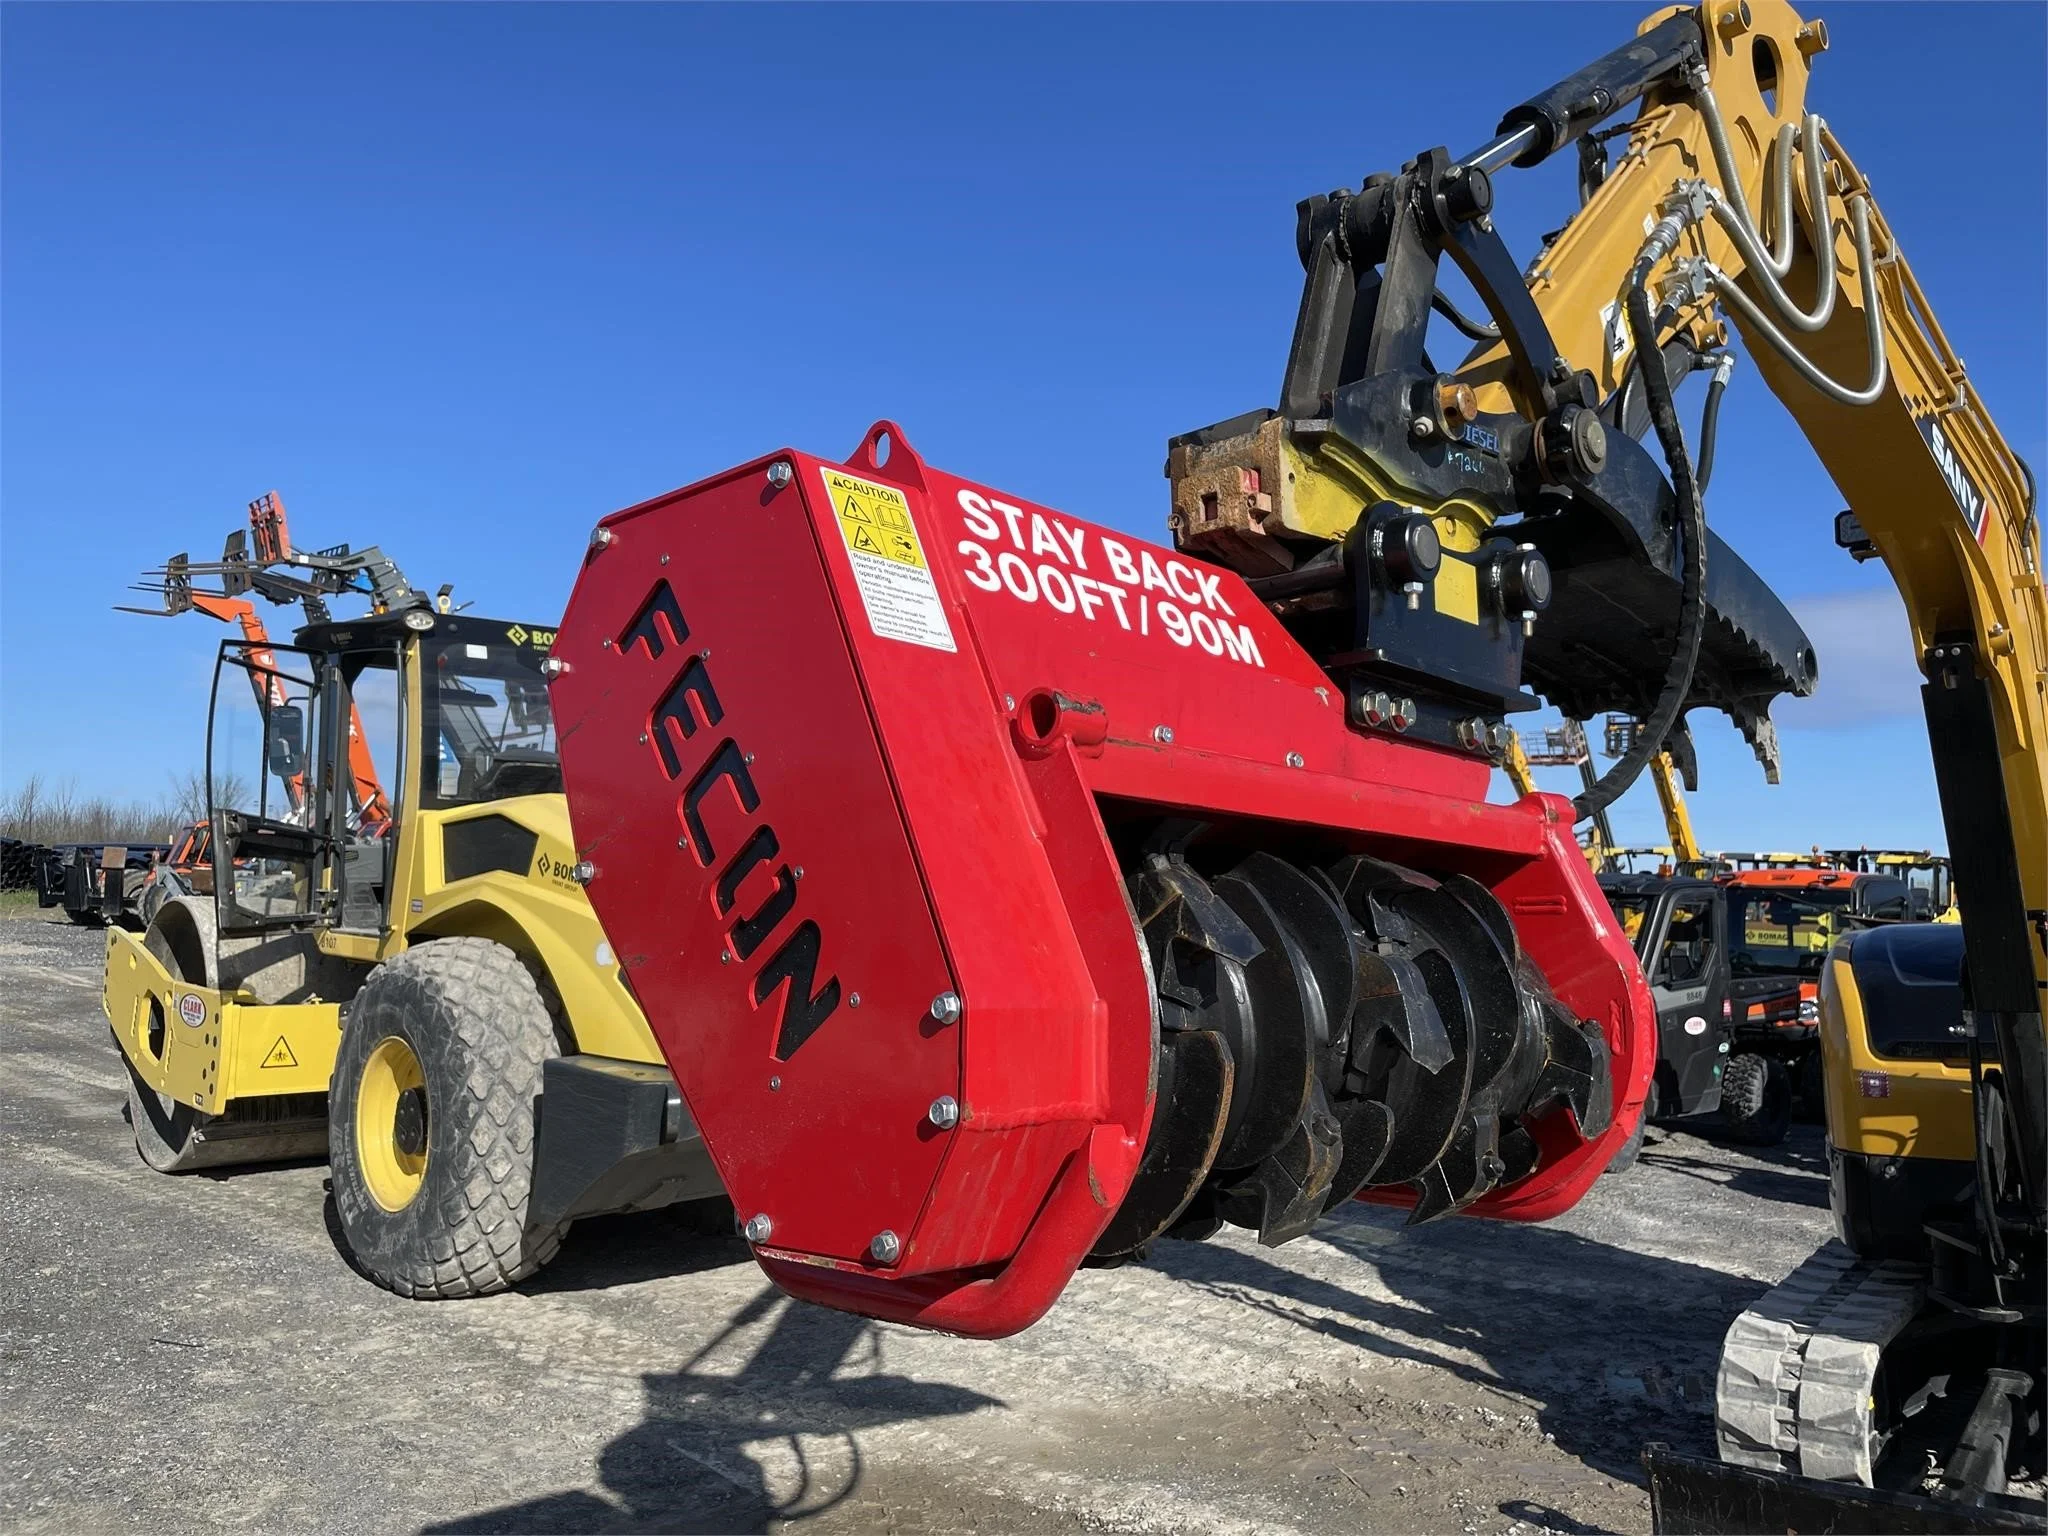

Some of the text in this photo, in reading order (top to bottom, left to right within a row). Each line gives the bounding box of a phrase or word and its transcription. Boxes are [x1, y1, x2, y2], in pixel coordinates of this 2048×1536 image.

[1464, 424, 1500, 453] IESEL
[1931, 422, 1978, 522] SANY
[842, 479, 900, 504] CAUTION
[957, 489, 1236, 617] STAY BACK
[613, 577, 841, 1063] FECON
[553, 861, 581, 884] BOM
[183, 999, 202, 1016] CLARK
